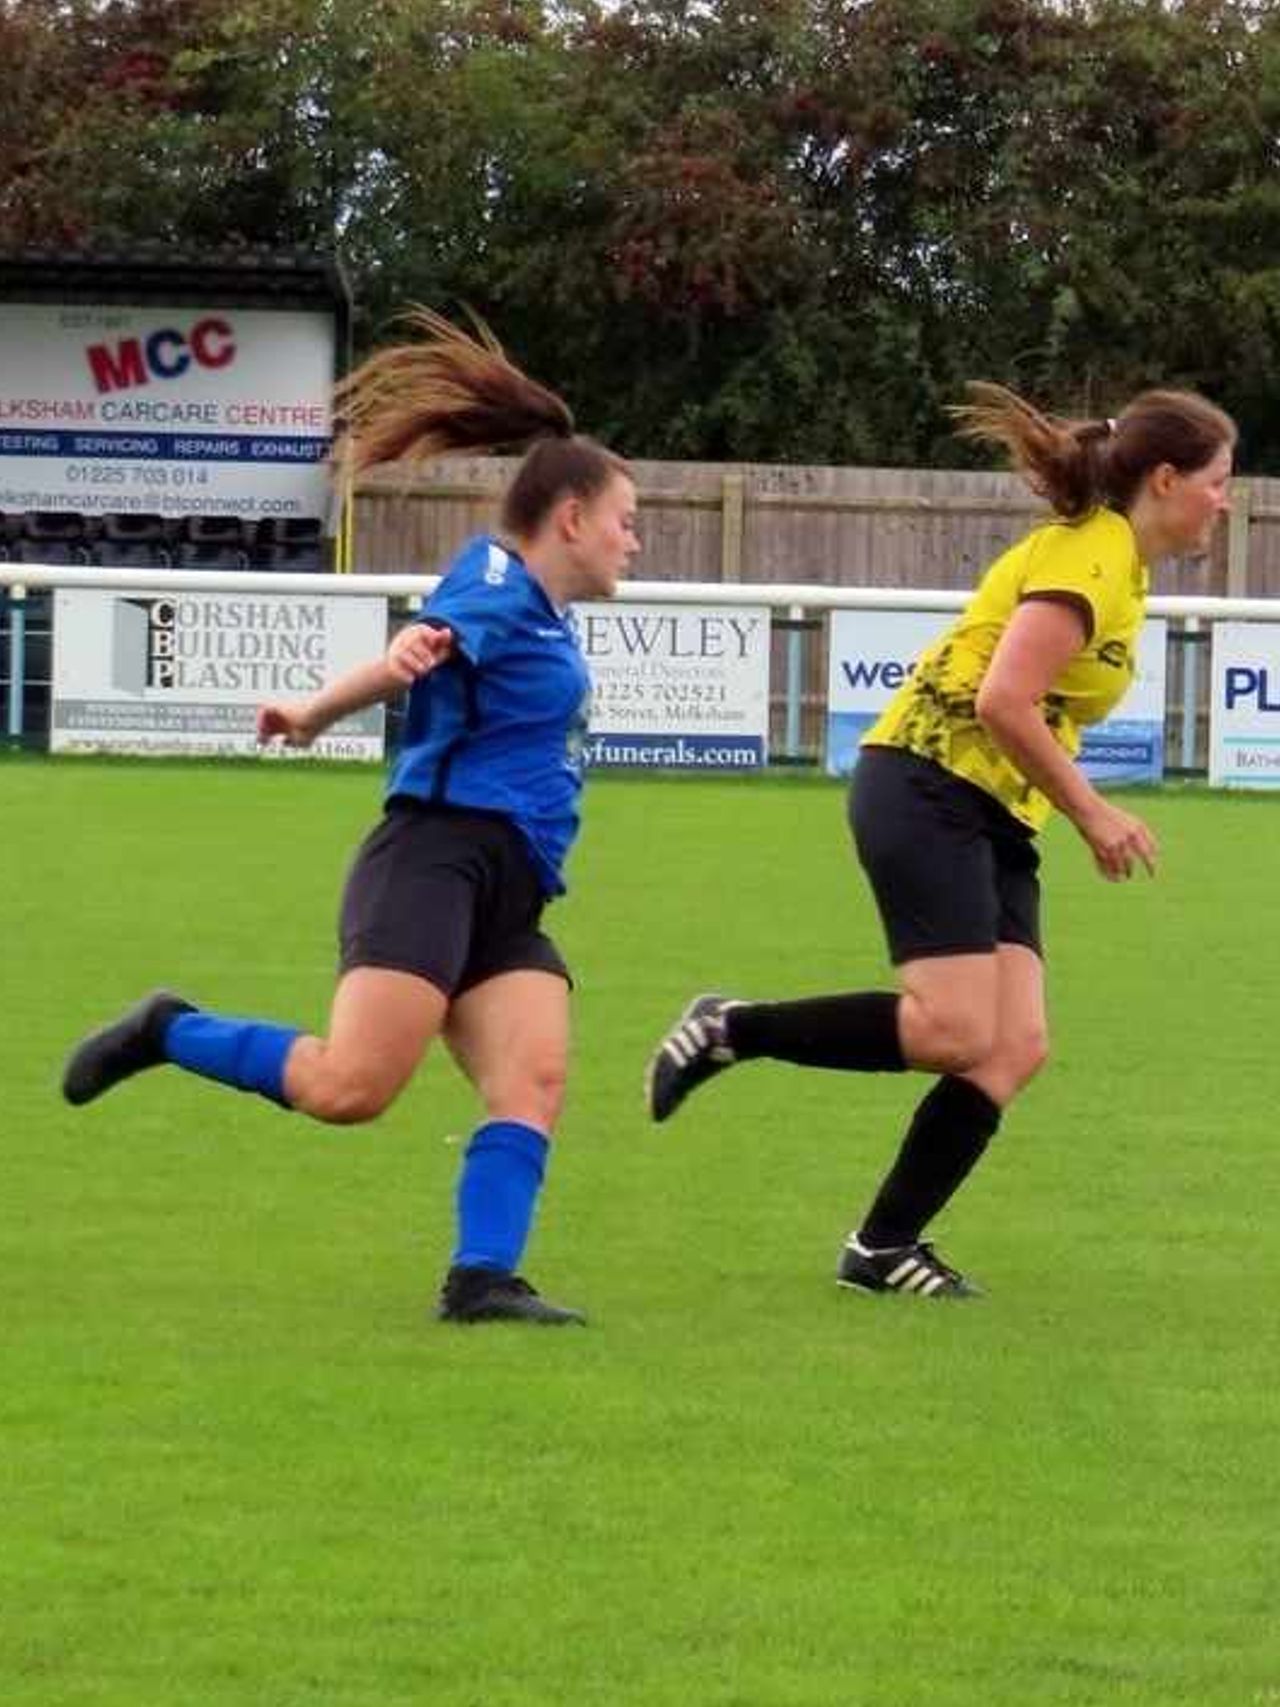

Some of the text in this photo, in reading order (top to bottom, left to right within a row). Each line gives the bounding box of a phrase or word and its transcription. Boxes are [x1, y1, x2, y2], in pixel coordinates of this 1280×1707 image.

[86, 317, 236, 394] MCC
[101, 402, 219, 424] CARCARE
[226, 404, 324, 427] CENTRE
[174, 439, 240, 455] REPAIRS
[65, 465, 209, 485] 01225 703 014
[152, 600, 326, 630] CORSHAM
[153, 632, 326, 660] BUILDING
[585, 616, 759, 658] EWLEY
[153, 662, 326, 690] PLASTICS
[596, 683, 644, 700] 1225
[582, 738, 757, 766] yfunerals.com
